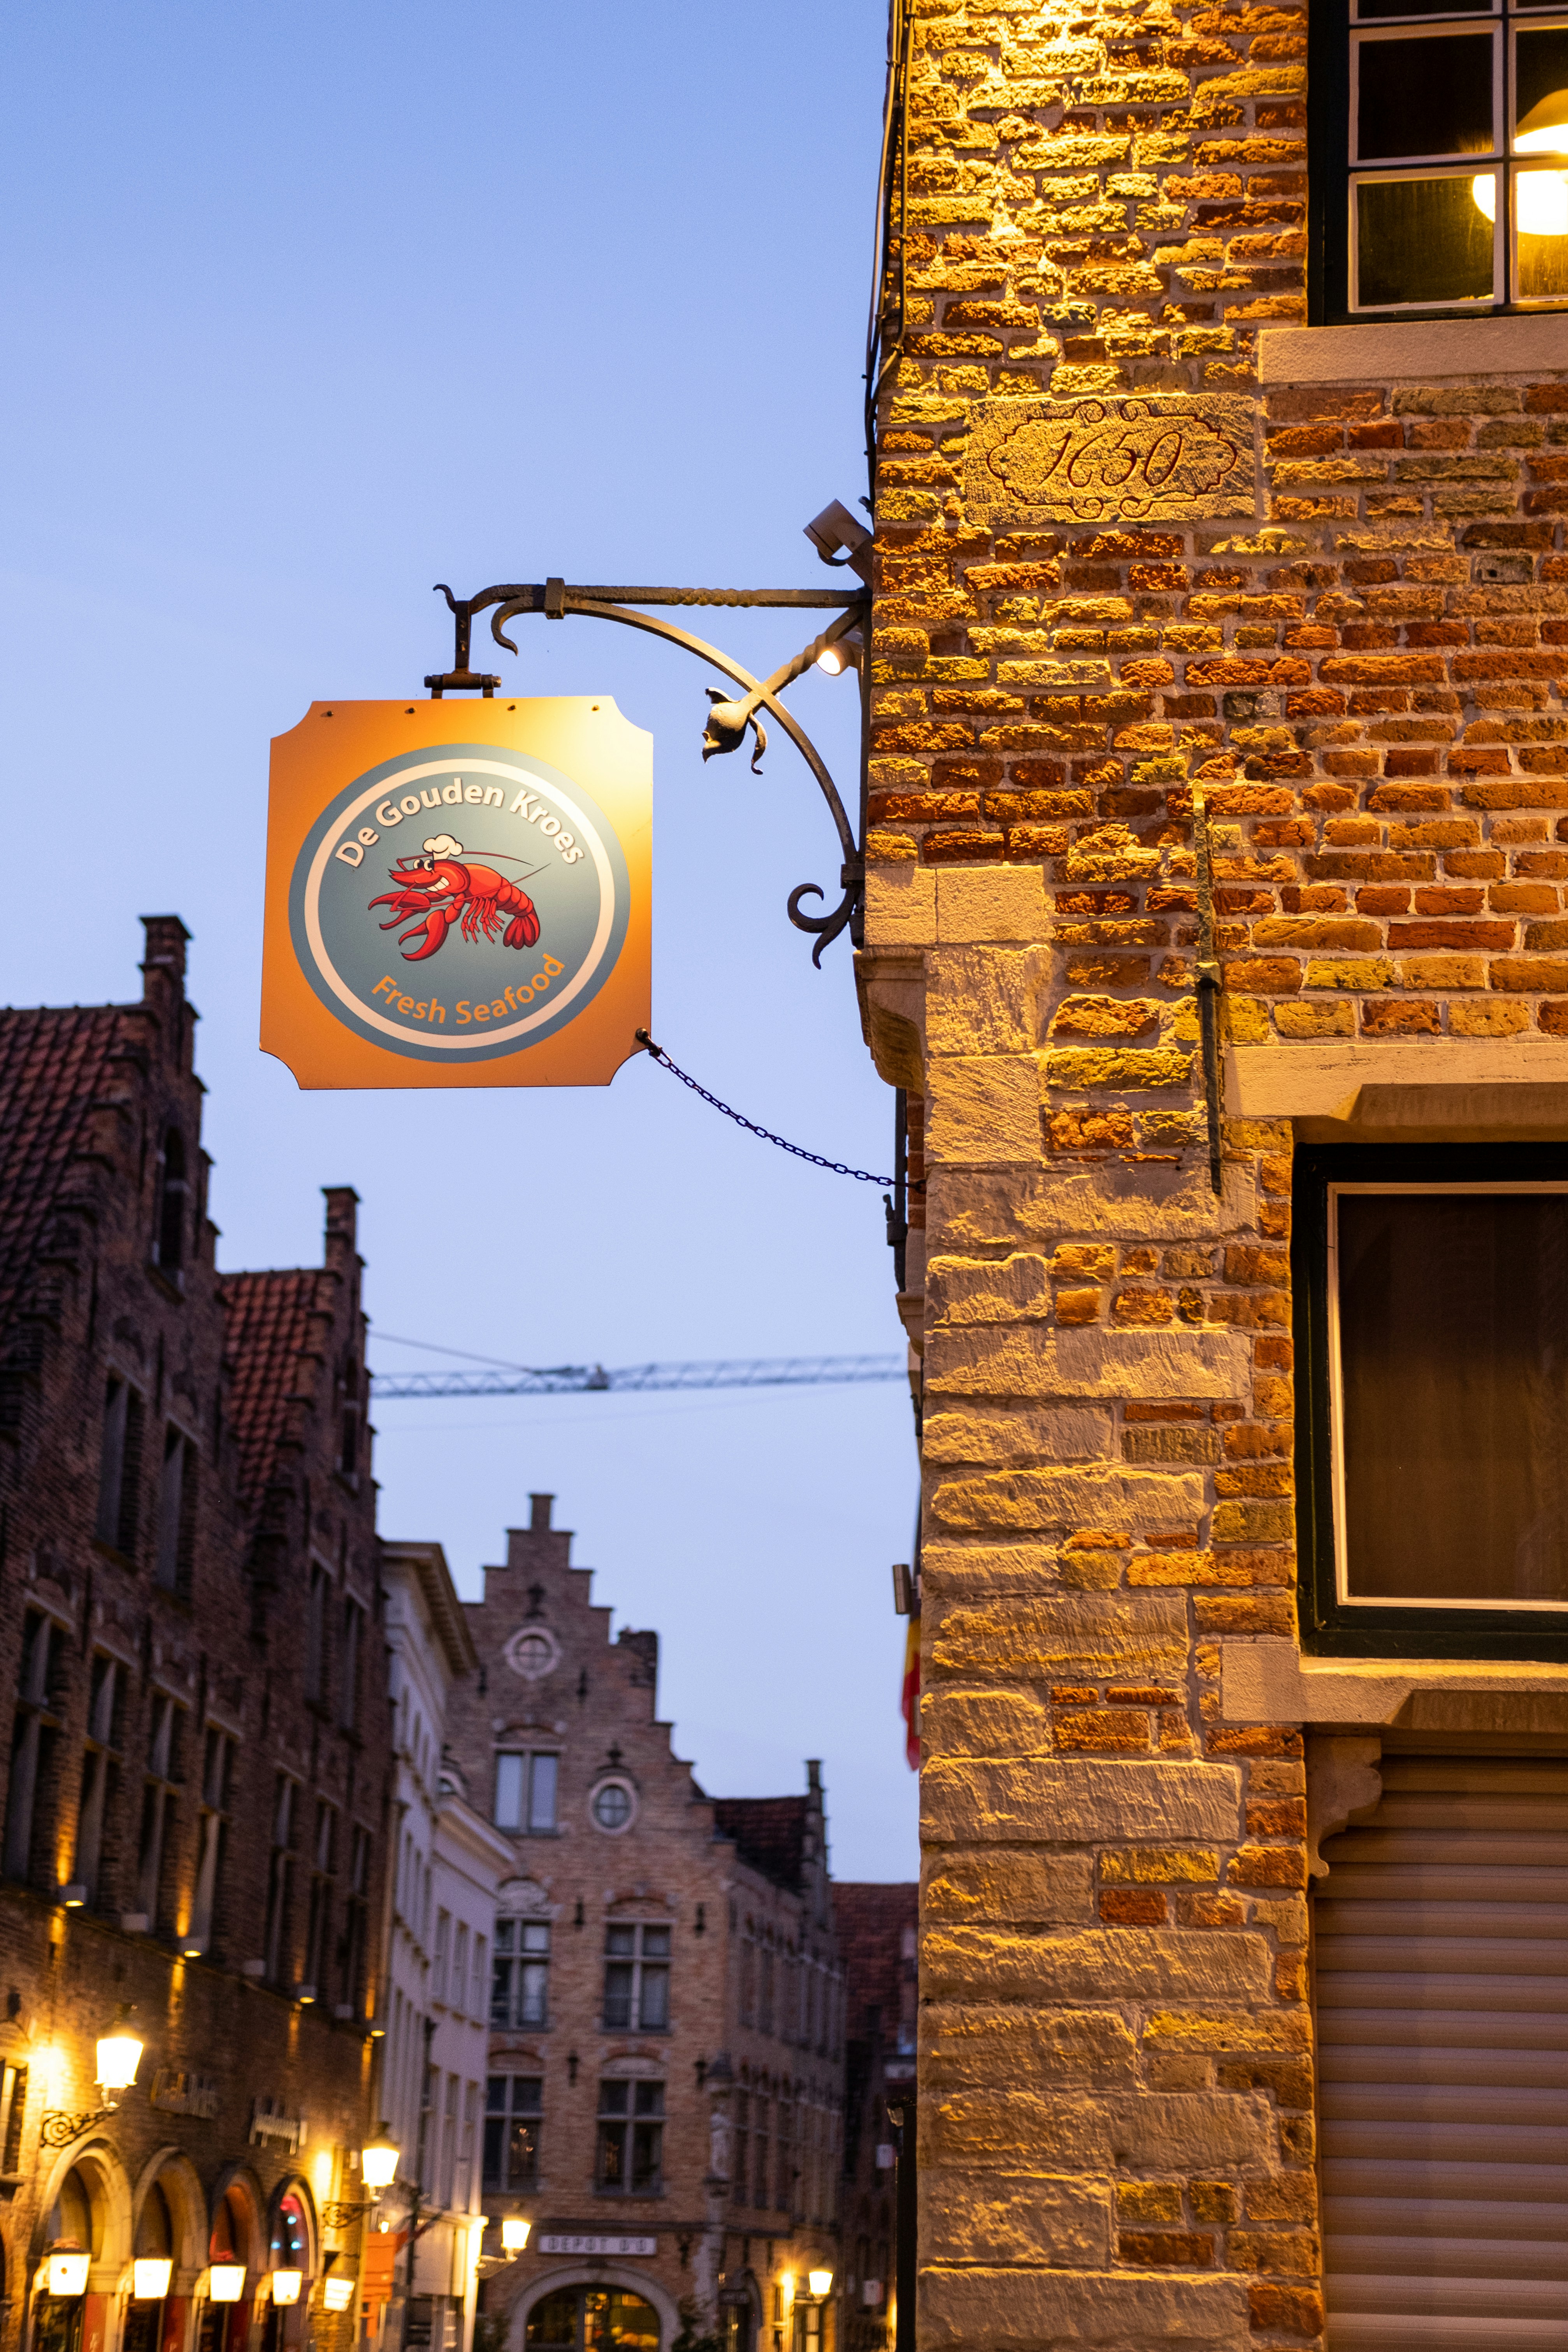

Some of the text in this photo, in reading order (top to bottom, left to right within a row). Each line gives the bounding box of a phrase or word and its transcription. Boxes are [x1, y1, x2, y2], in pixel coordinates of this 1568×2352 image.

[1037, 432, 1182, 487] 1650
[335, 778, 584, 868] De Gouden Kroes
[371, 953, 565, 1025] Fresh Seafood
